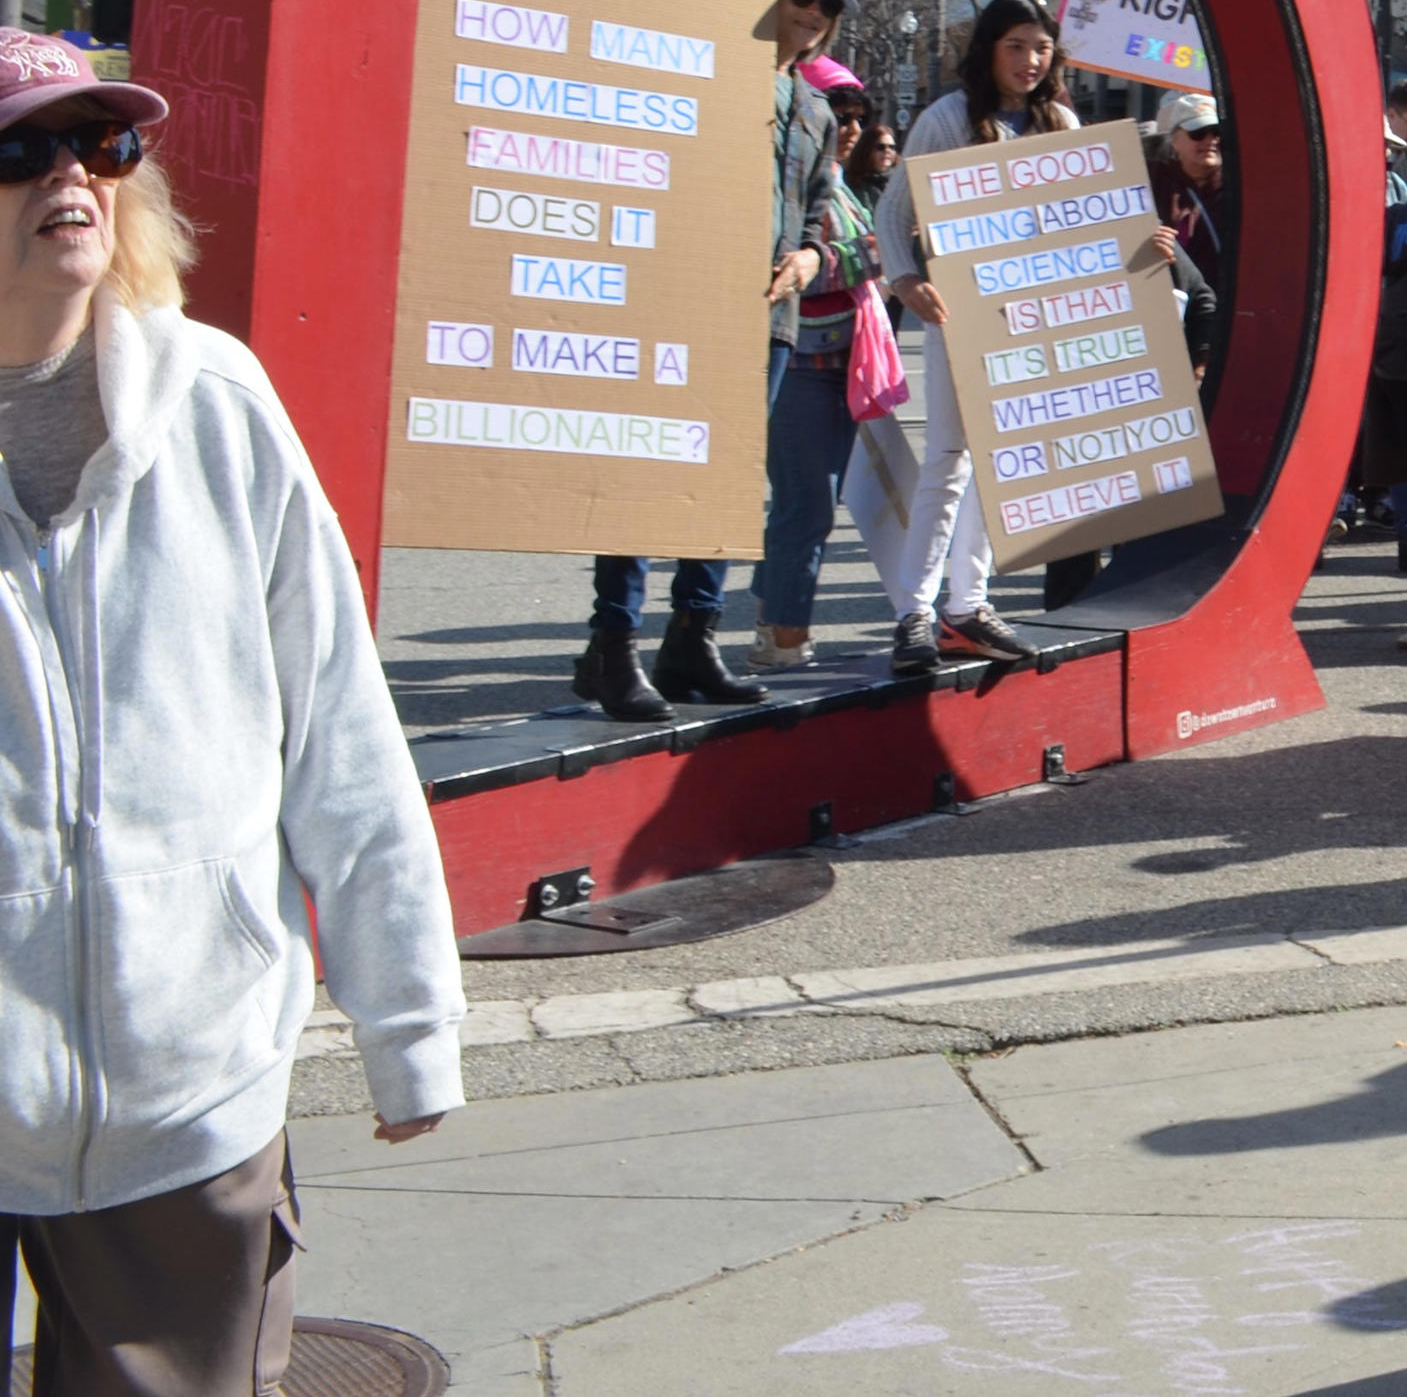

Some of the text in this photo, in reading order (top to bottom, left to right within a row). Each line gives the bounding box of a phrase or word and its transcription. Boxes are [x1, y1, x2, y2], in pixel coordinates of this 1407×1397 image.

[461, 1, 709, 74] HOW MANY
[1126, 33, 1207, 71] EXIST
[459, 67, 694, 131] HOMELESS
[469, 129, 667, 187] FAMILIES
[934, 145, 1110, 202] THE GOOD
[475, 189, 650, 243] DOES IT
[933, 186, 1147, 253] THING ABOUT
[516, 258, 622, 300] TAKE
[978, 241, 1120, 292] SCIENCE
[1009, 283, 1128, 331] IS THAT
[431, 326, 682, 381] TO MAKE A
[988, 328, 1143, 383] IT'S TRUE
[996, 371, 1160, 428] WHETHER
[412, 401, 706, 459] BILLIONAIRE?
[997, 408, 1197, 480] OR NOT YOU
[1003, 459, 1191, 532] BELIEVE IT.
